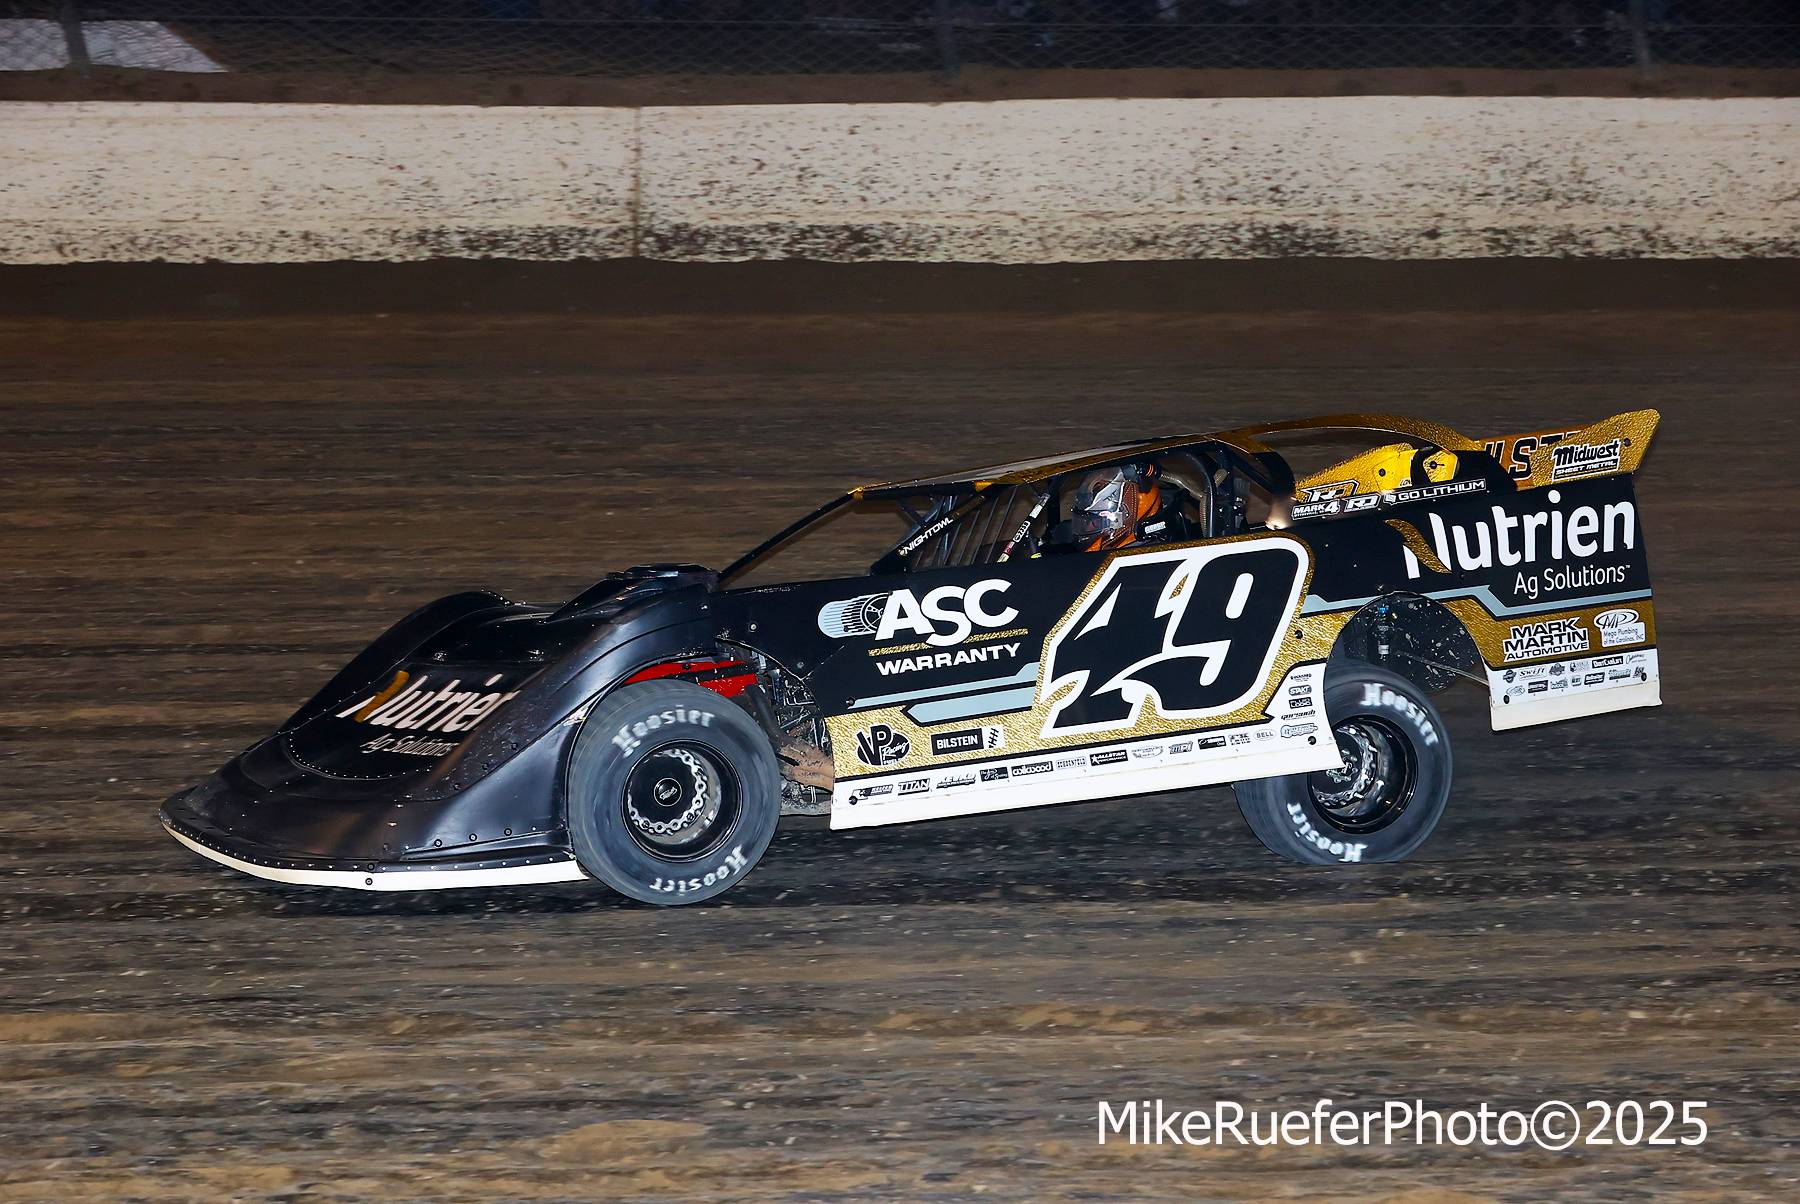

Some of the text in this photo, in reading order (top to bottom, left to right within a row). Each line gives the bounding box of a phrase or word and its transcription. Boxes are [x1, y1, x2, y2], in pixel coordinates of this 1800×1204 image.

[1553, 440, 1620, 467] Midwest
[1555, 460, 1617, 476] SHEET METAL
[1422, 480, 1485, 498] LITHIUM
[1293, 503, 1325, 515] MARK
[902, 517, 954, 555] NIGHTOWL
[1404, 490, 1634, 579] Nutrien
[1513, 571, 1539, 600] Ag
[875, 578, 1019, 647] ASC
[1045, 542, 1304, 735] 49
[1504, 629, 1588, 652] MARTIN
[1512, 620, 1579, 639] MARK
[876, 642, 1021, 676] WARRANTY
[1506, 642, 1588, 660] AUTOMOTIVE
[856, 725, 892, 765] VP
[936, 735, 979, 750] BILSTEIN
[1012, 762, 1052, 776] wilwood
[898, 780, 929, 793] TITAN
